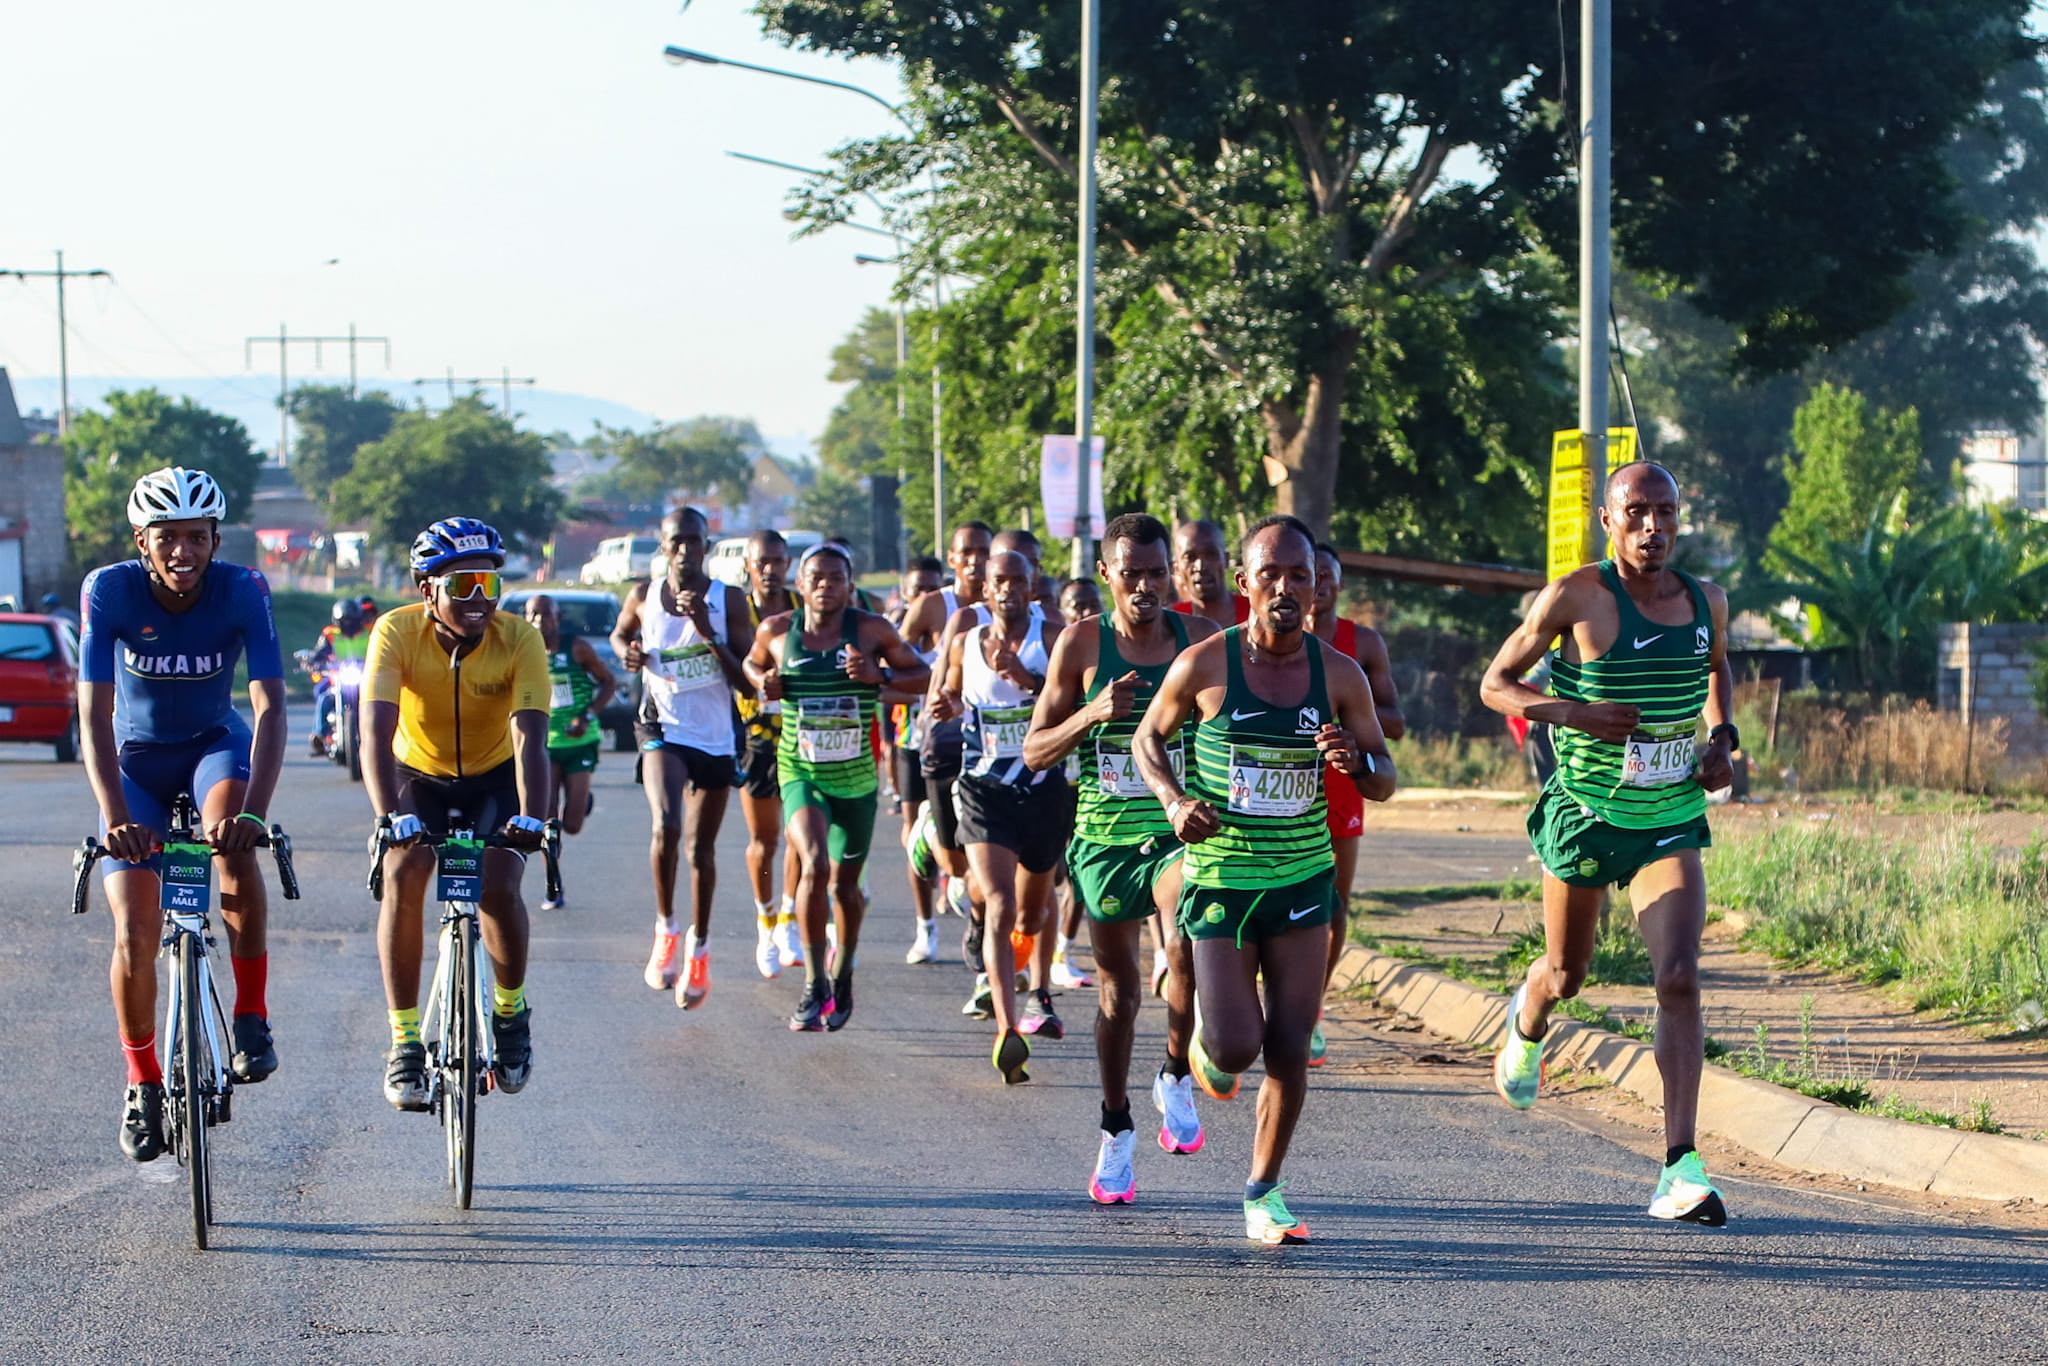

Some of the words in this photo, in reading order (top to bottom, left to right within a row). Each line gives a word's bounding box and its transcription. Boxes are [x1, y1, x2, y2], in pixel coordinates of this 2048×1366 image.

[459, 537, 485, 547] 4116
[124, 648, 223, 674] VUKANI
[816, 730, 859, 751] 42074
[1000, 723, 1027, 745] 419
[1629, 744, 1641, 757] A
[1650, 739, 1693, 771] 4186
[1102, 755, 1113, 768] A
[1628, 760, 1646, 772] MO
[1102, 771, 1119, 782] MO
[1233, 768, 1246, 782] A
[1232, 785, 1251, 798] MO
[1255, 770, 1315, 800] 42086
[444, 858, 476, 867] SOWETO
[169, 865, 204, 874] SOWETO
[447, 888, 471, 897] MALE
[172, 896, 198, 906] MALE
